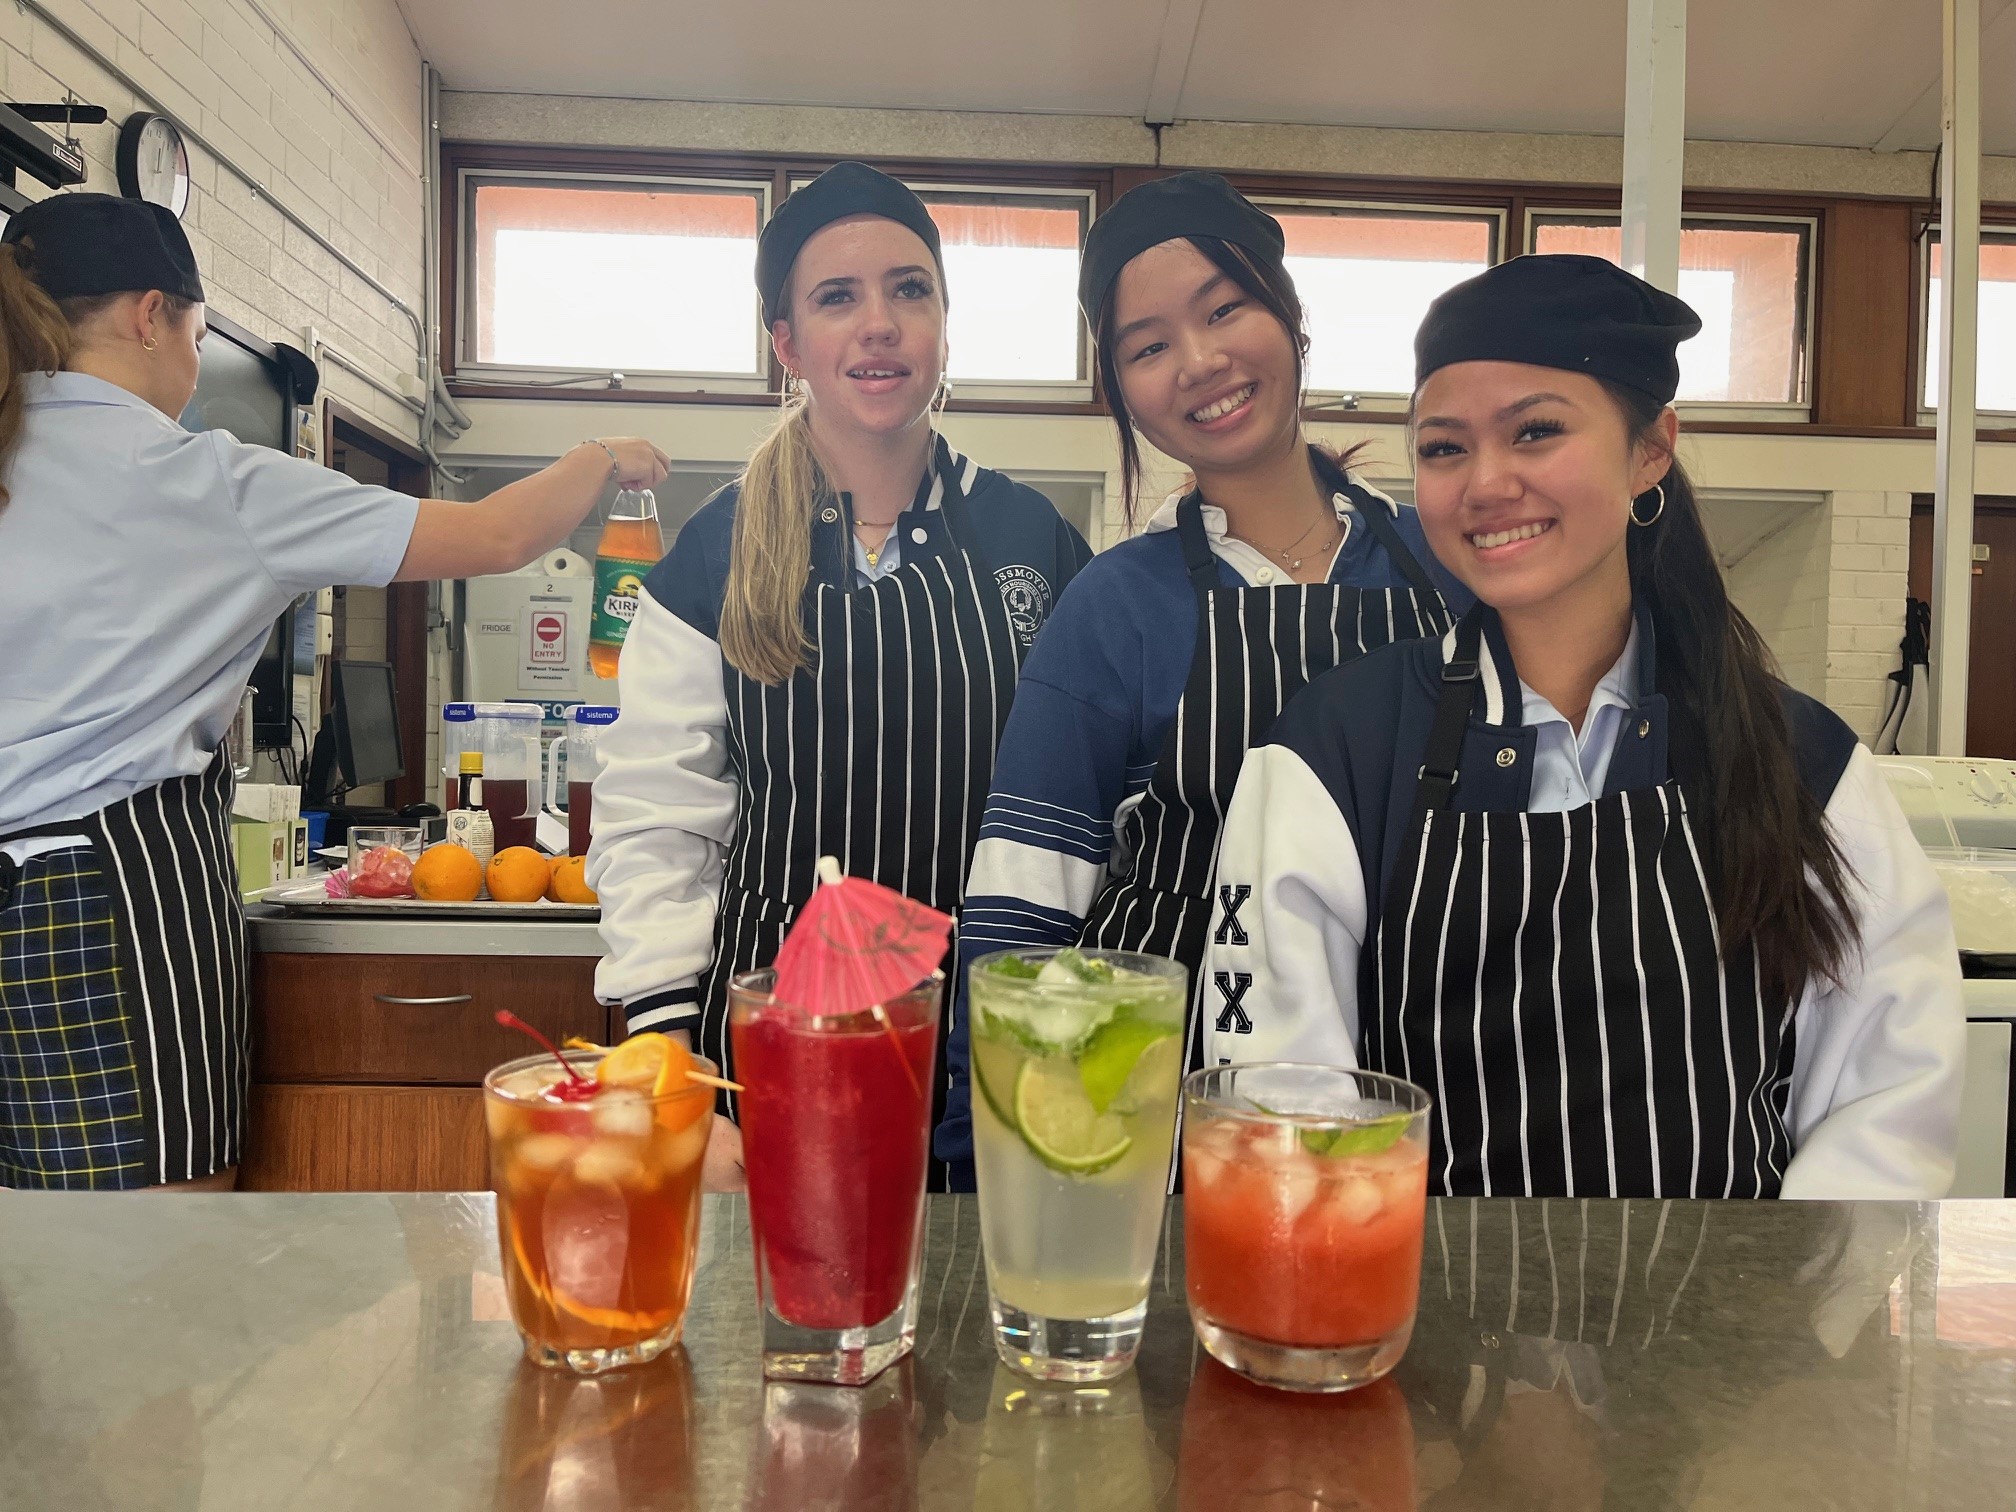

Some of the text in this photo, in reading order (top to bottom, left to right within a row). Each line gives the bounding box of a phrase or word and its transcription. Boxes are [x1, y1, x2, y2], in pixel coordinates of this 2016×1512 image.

[547, 584, 553, 592] 2
[481, 624, 512, 632] FRIDGE
[536, 703, 565, 719] FO
[586, 711, 613, 719] sistema
